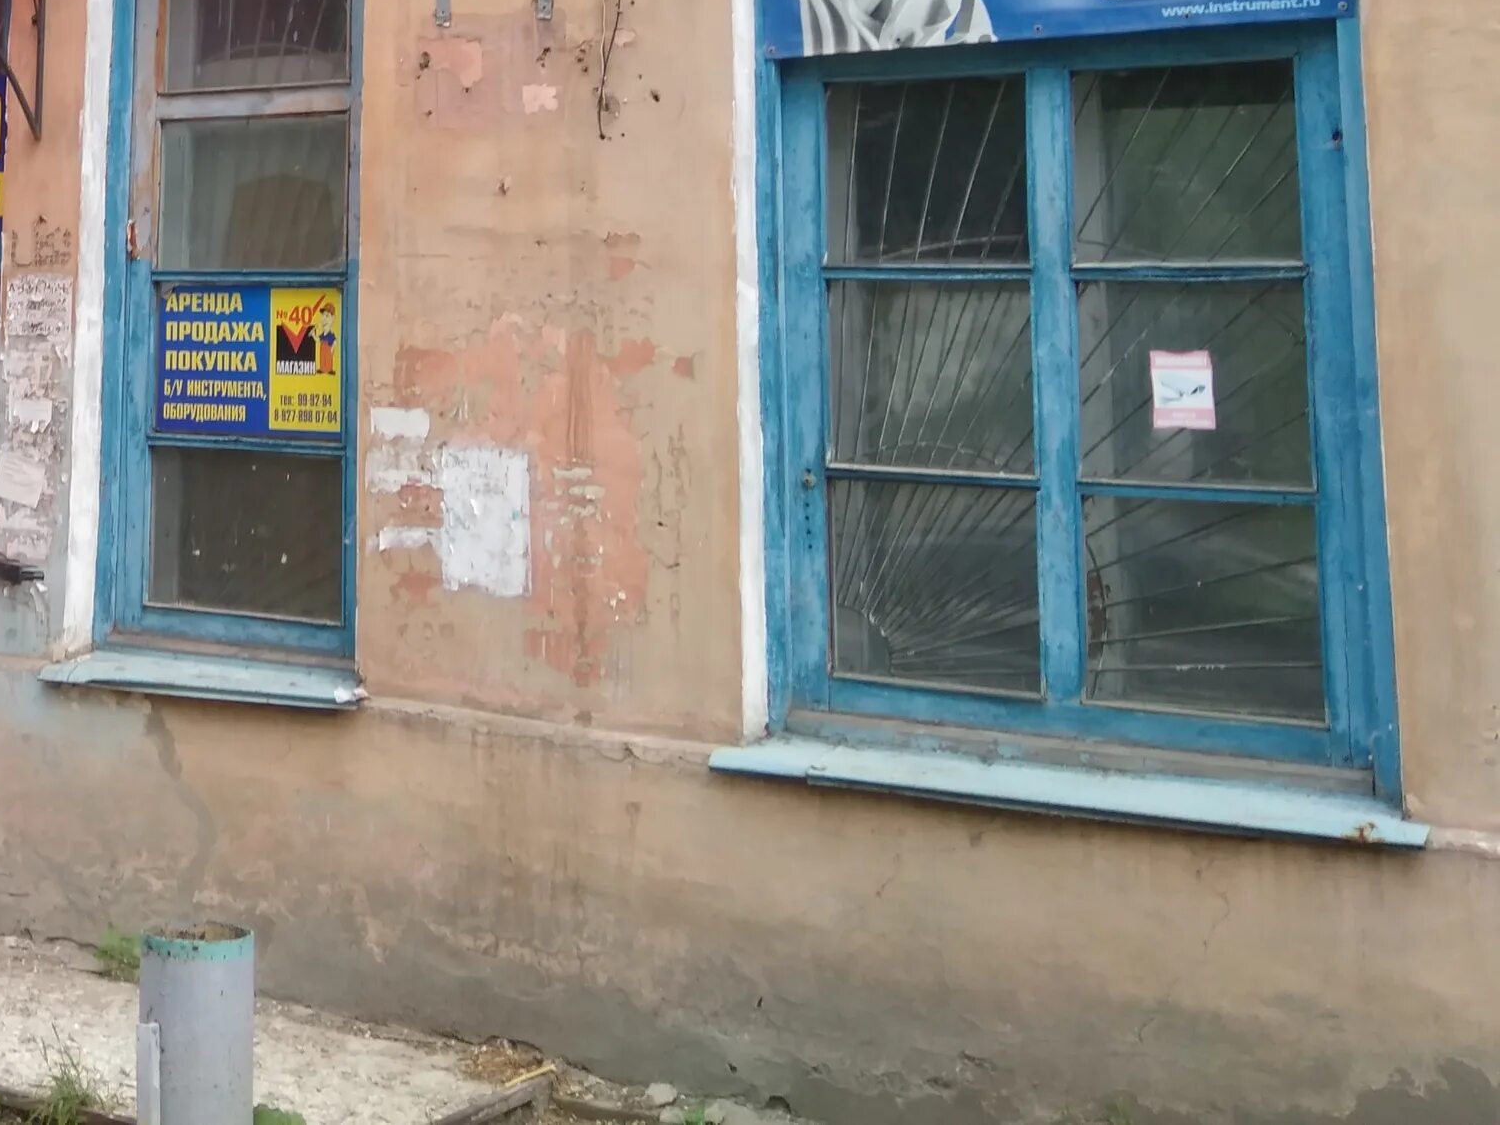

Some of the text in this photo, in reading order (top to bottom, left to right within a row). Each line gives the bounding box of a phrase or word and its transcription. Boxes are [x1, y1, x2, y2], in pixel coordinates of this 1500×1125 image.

[165, 292, 243, 315] АРЕНДА
[288, 306, 313, 325] 40
[165, 321, 265, 344] ПРОДАЖА
[165, 350, 258, 372] ПОКУПКА
[276, 360, 317, 375] МАГАЗИН
[163, 378, 268, 401] Б/У ИНСТРУМЕНТА,
[163, 402, 246, 423] ОБОРУДОВАНИЯ
